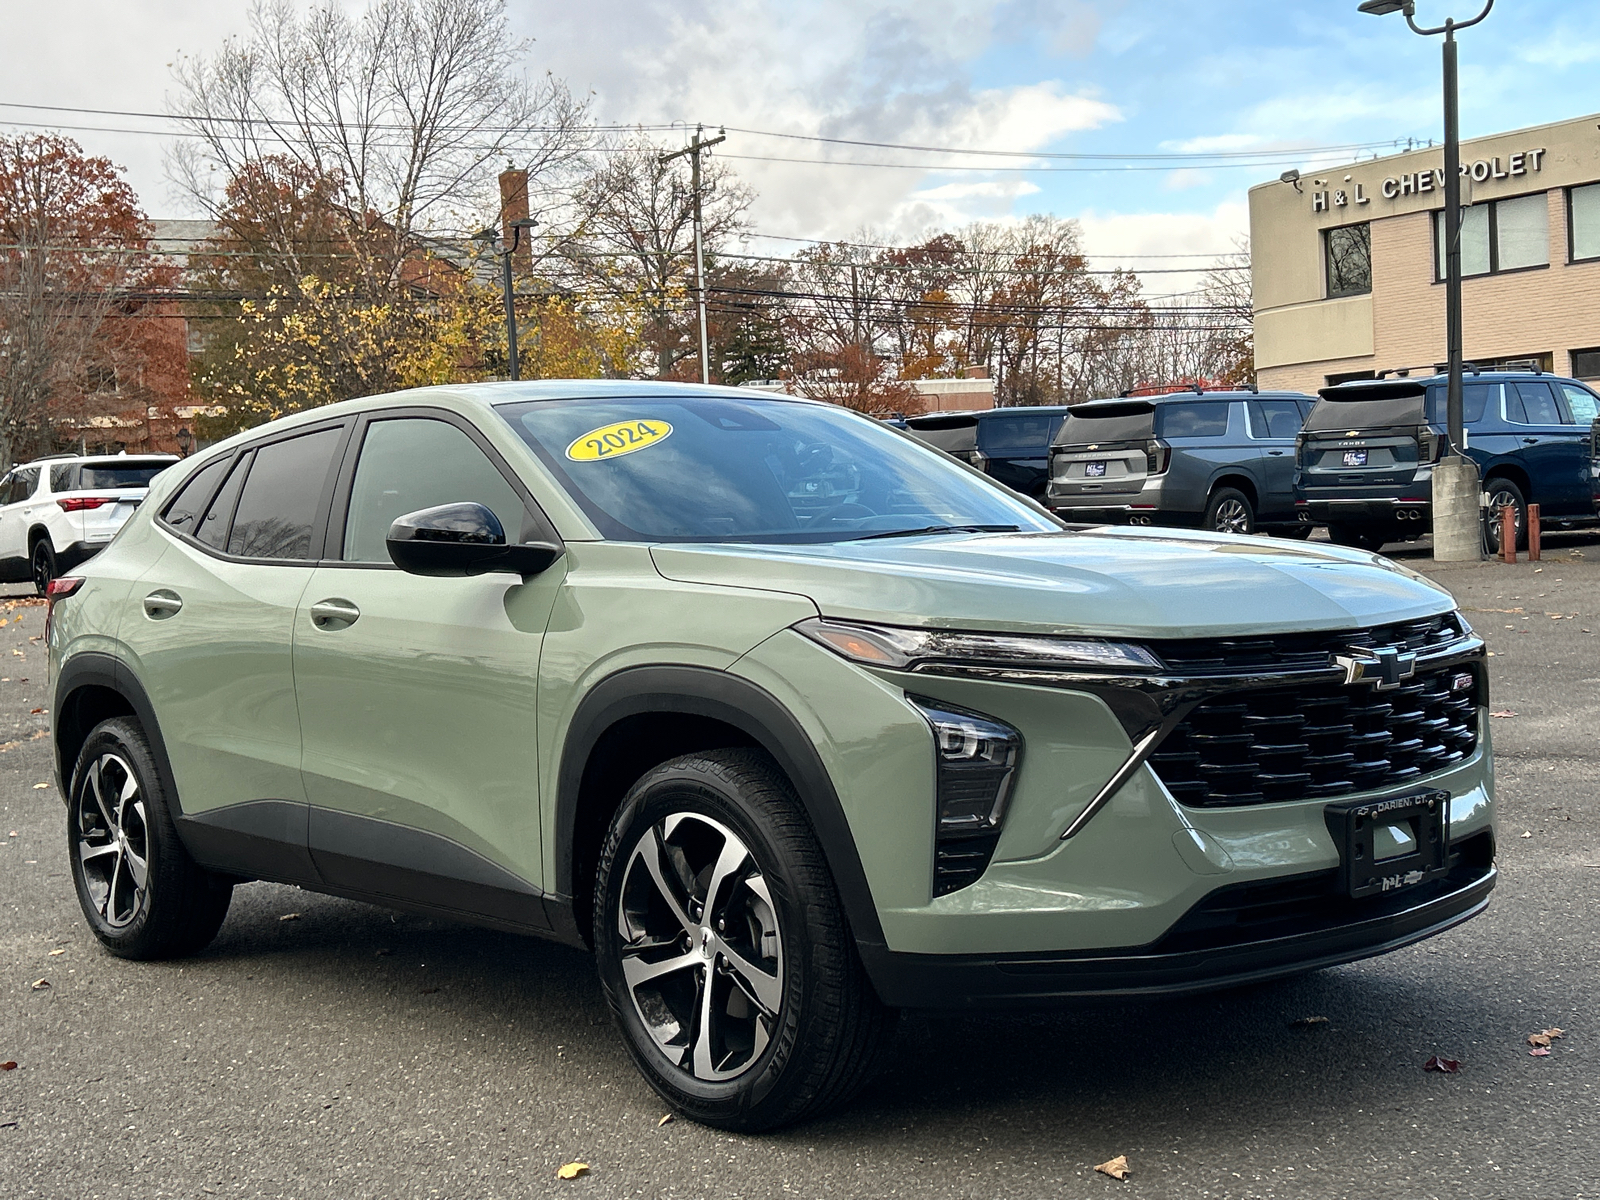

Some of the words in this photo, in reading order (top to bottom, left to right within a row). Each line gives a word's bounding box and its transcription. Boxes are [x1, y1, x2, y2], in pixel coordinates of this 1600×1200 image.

[1312, 191, 1329, 212] H
[1334, 190, 1348, 206] &
[1355, 184, 1370, 204] L
[586, 422, 659, 456] 2024
